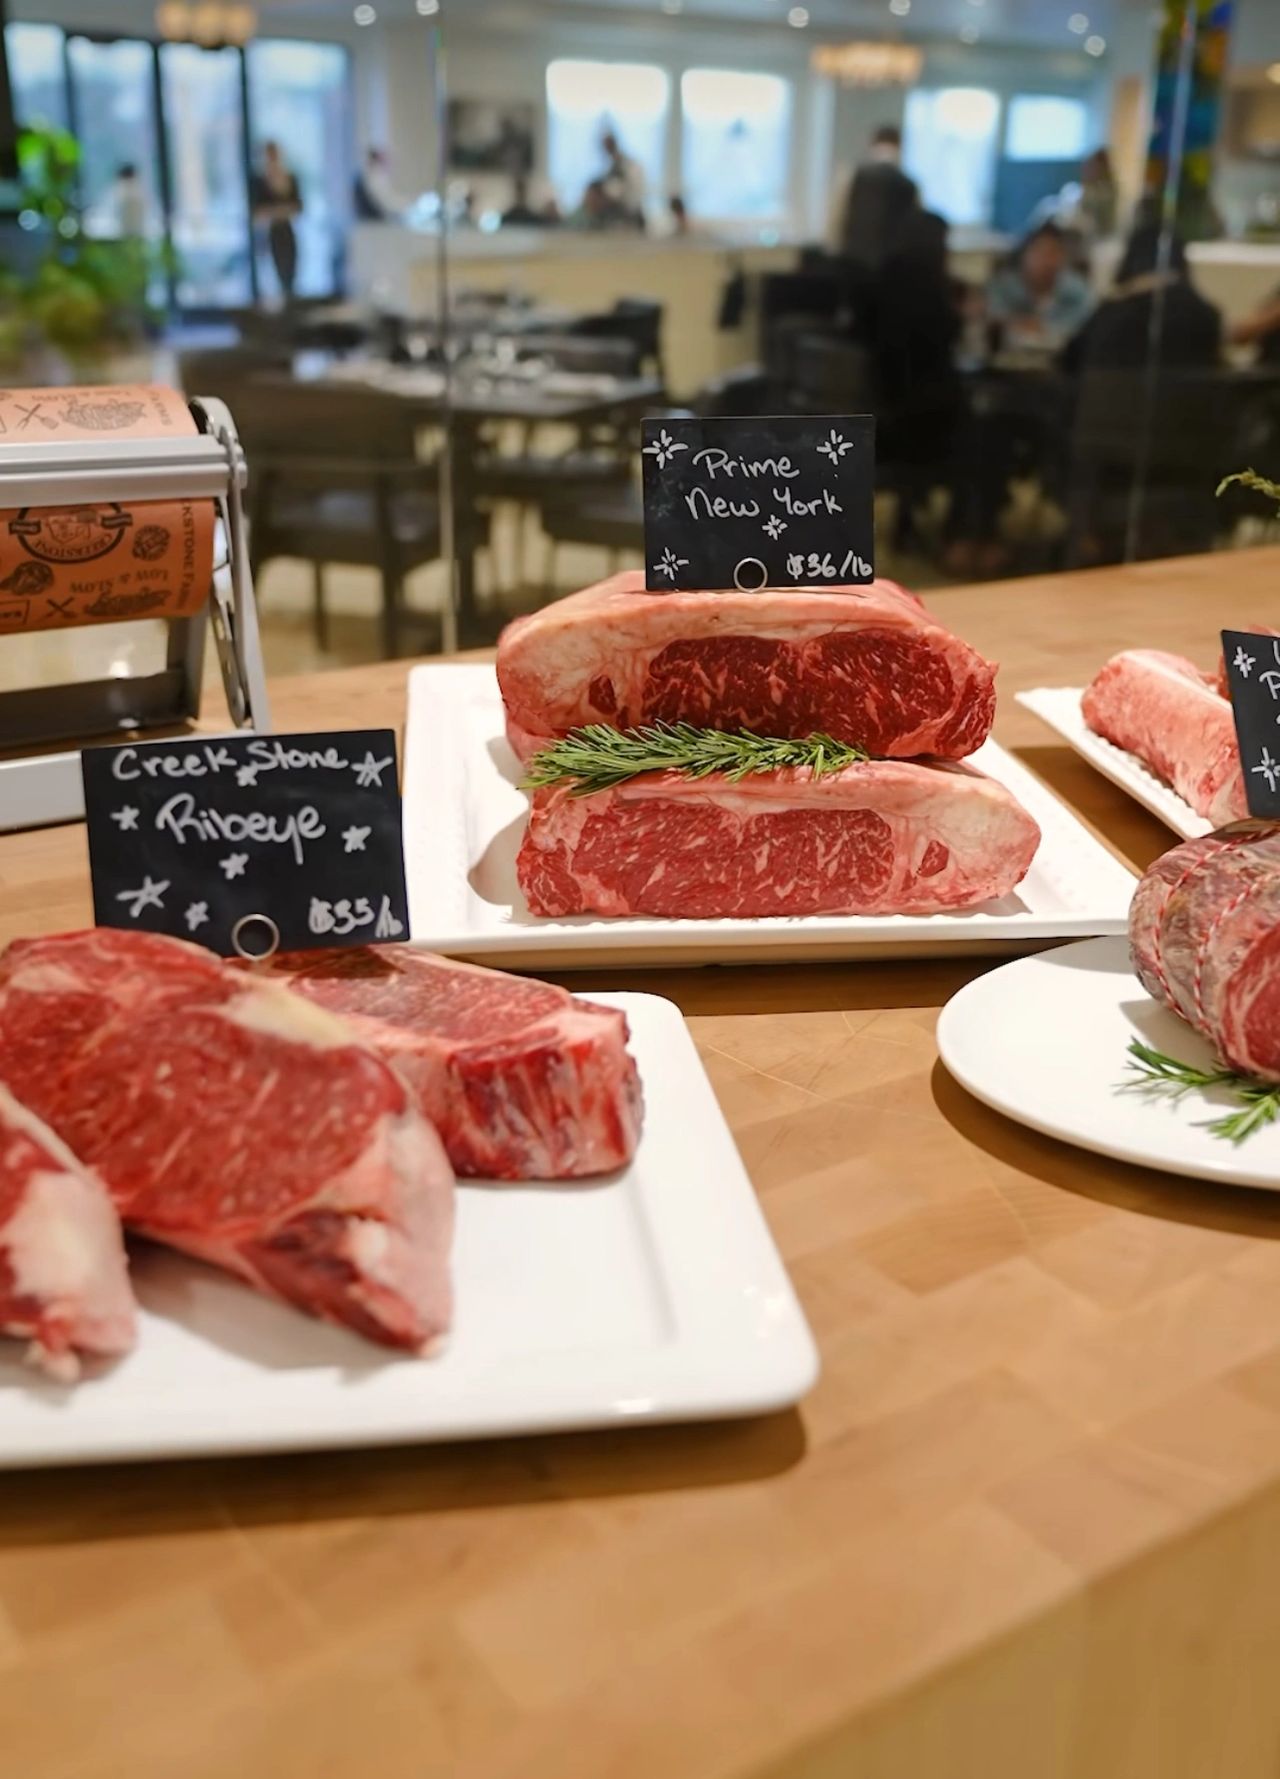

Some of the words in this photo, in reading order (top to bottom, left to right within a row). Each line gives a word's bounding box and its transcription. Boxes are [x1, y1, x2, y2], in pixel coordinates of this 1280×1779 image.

[692, 448, 800, 479] Prime
[685, 487, 760, 520] New
[773, 487, 843, 516] York
[787, 550, 873, 580] $36/lb
[112, 746, 237, 780] Creek
[246, 741, 349, 772] Stone
[155, 792, 327, 865] Ribeye
